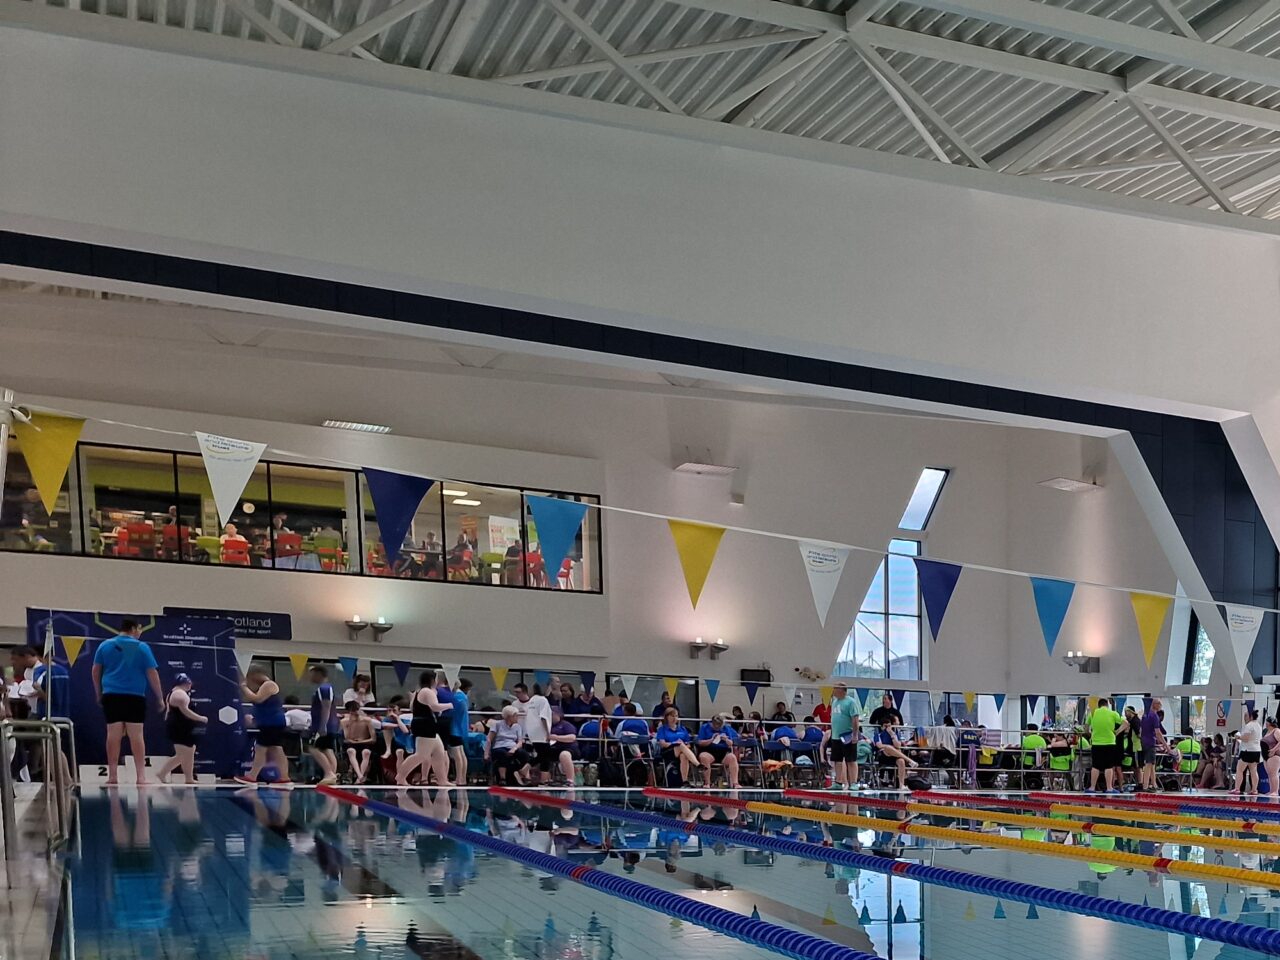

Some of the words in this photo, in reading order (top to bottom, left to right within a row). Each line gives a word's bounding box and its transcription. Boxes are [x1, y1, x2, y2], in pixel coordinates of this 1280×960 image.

[234, 618, 271, 628] otland
[144, 757, 152, 767] 1
[98, 766, 108, 776] 2
